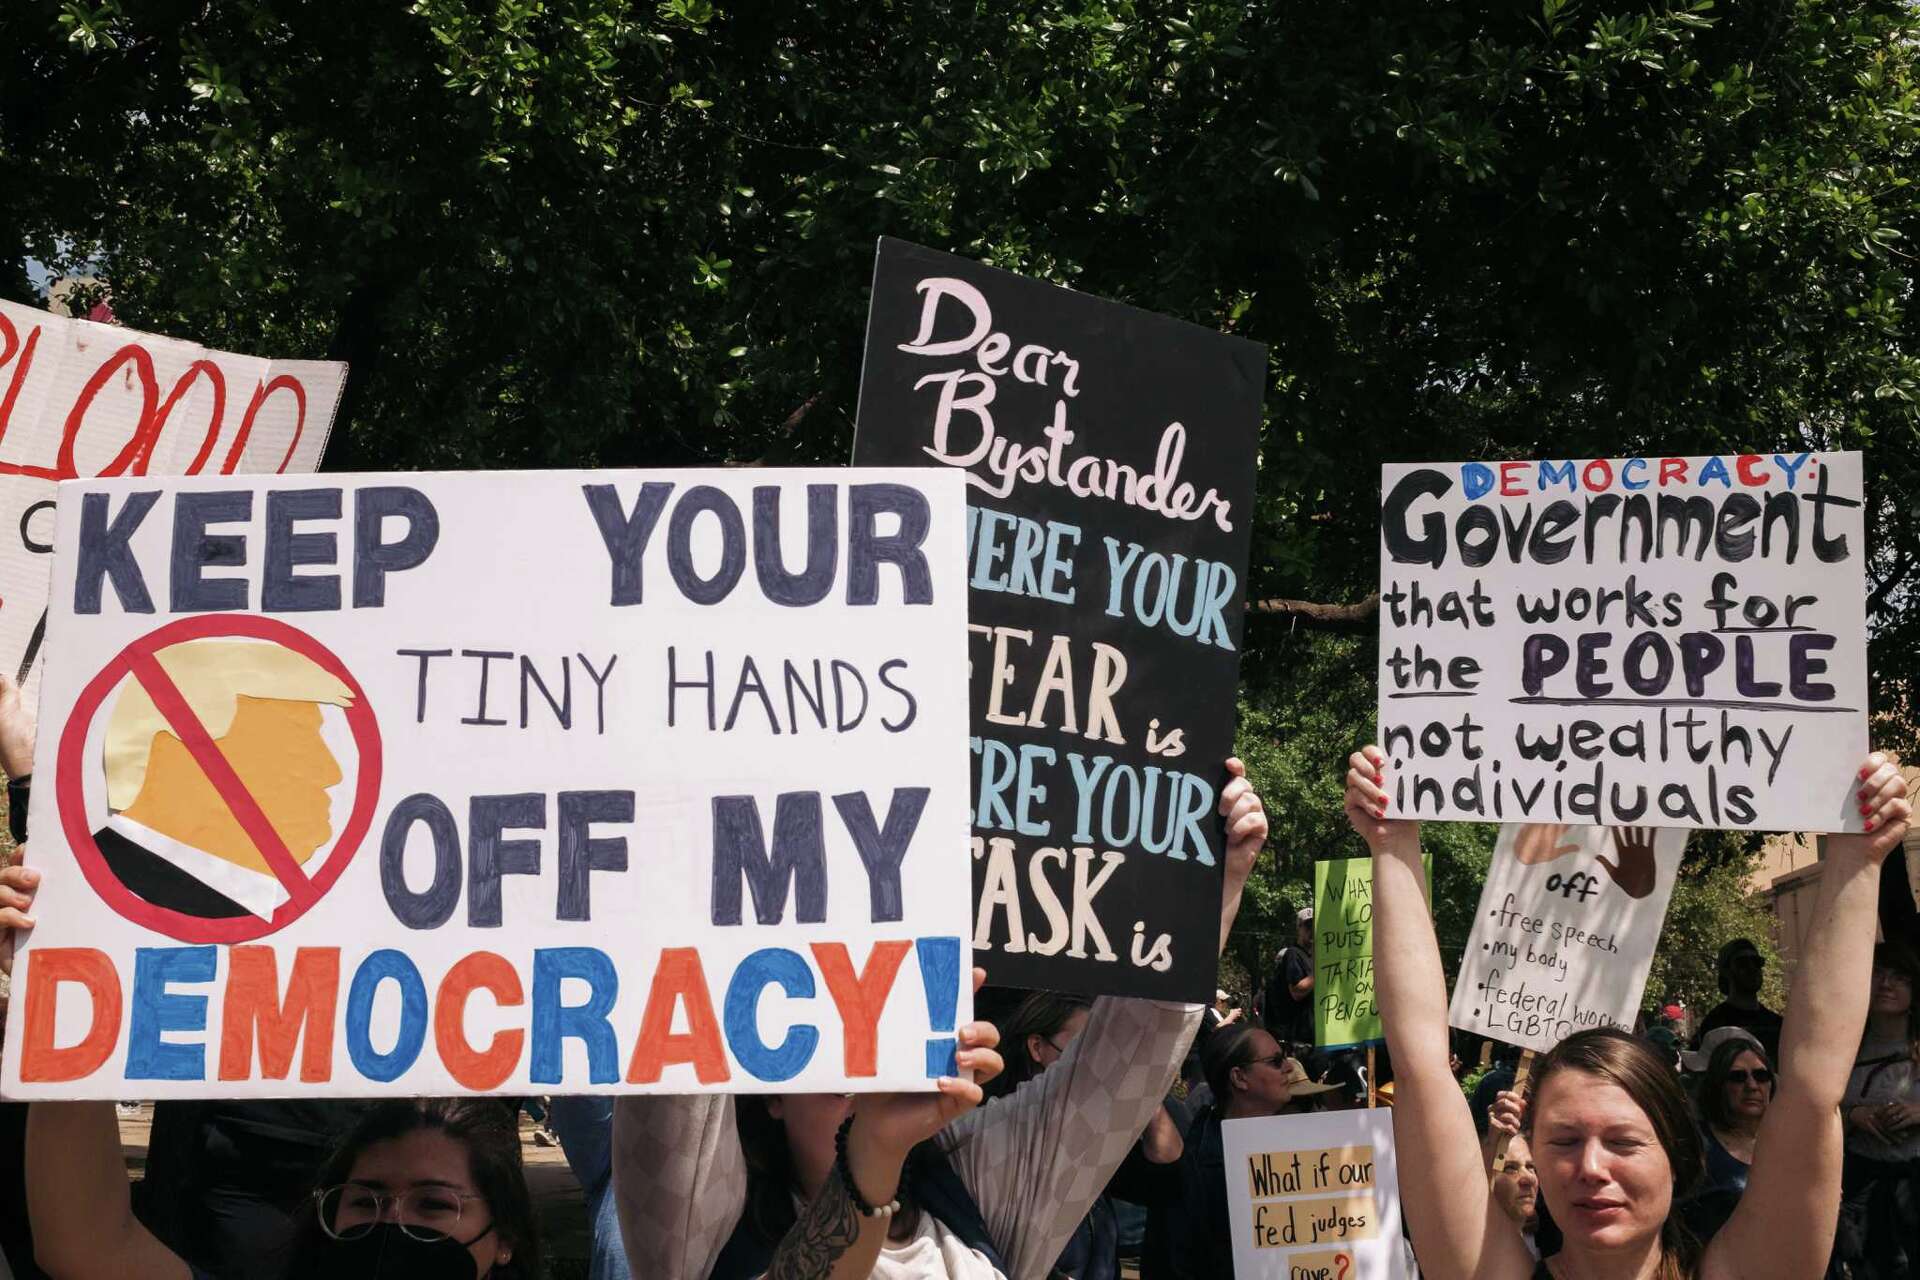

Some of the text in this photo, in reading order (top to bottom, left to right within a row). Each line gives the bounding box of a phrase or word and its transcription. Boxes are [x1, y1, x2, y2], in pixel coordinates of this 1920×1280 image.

[897, 277, 1080, 397] Dear
[914, 368, 1233, 533] Bystander
[1460, 452, 1817, 501] DEMOCRACY:
[74, 486, 440, 614] KEEP
[582, 482, 934, 606] YOUR
[1381, 463, 1861, 569] Government
[1103, 535, 1237, 652] YOUR
[1382, 572, 1818, 629] that works for
[397, 646, 918, 735] TINY HANDS
[1386, 631, 1838, 700] the PEOPLE
[1145, 718, 1186, 756] is
[1384, 707, 1793, 787] not wealthy
[1066, 752, 1216, 867] YOUR
[1391, 759, 1757, 826] individuals
[380, 787, 931, 930] OFF MY
[1545, 871, 1599, 902] off
[971, 836, 1173, 972] ASK is
[1499, 893, 1619, 954] free speech
[1322, 930, 1367, 953] PUTS
[1490, 940, 1568, 982] my body
[19, 936, 961, 1091] DEMOCRACY!
[1482, 968, 1568, 1017] federal
[1249, 1152, 1374, 1197] What if our
[1254, 1205, 1366, 1246] fed judges
